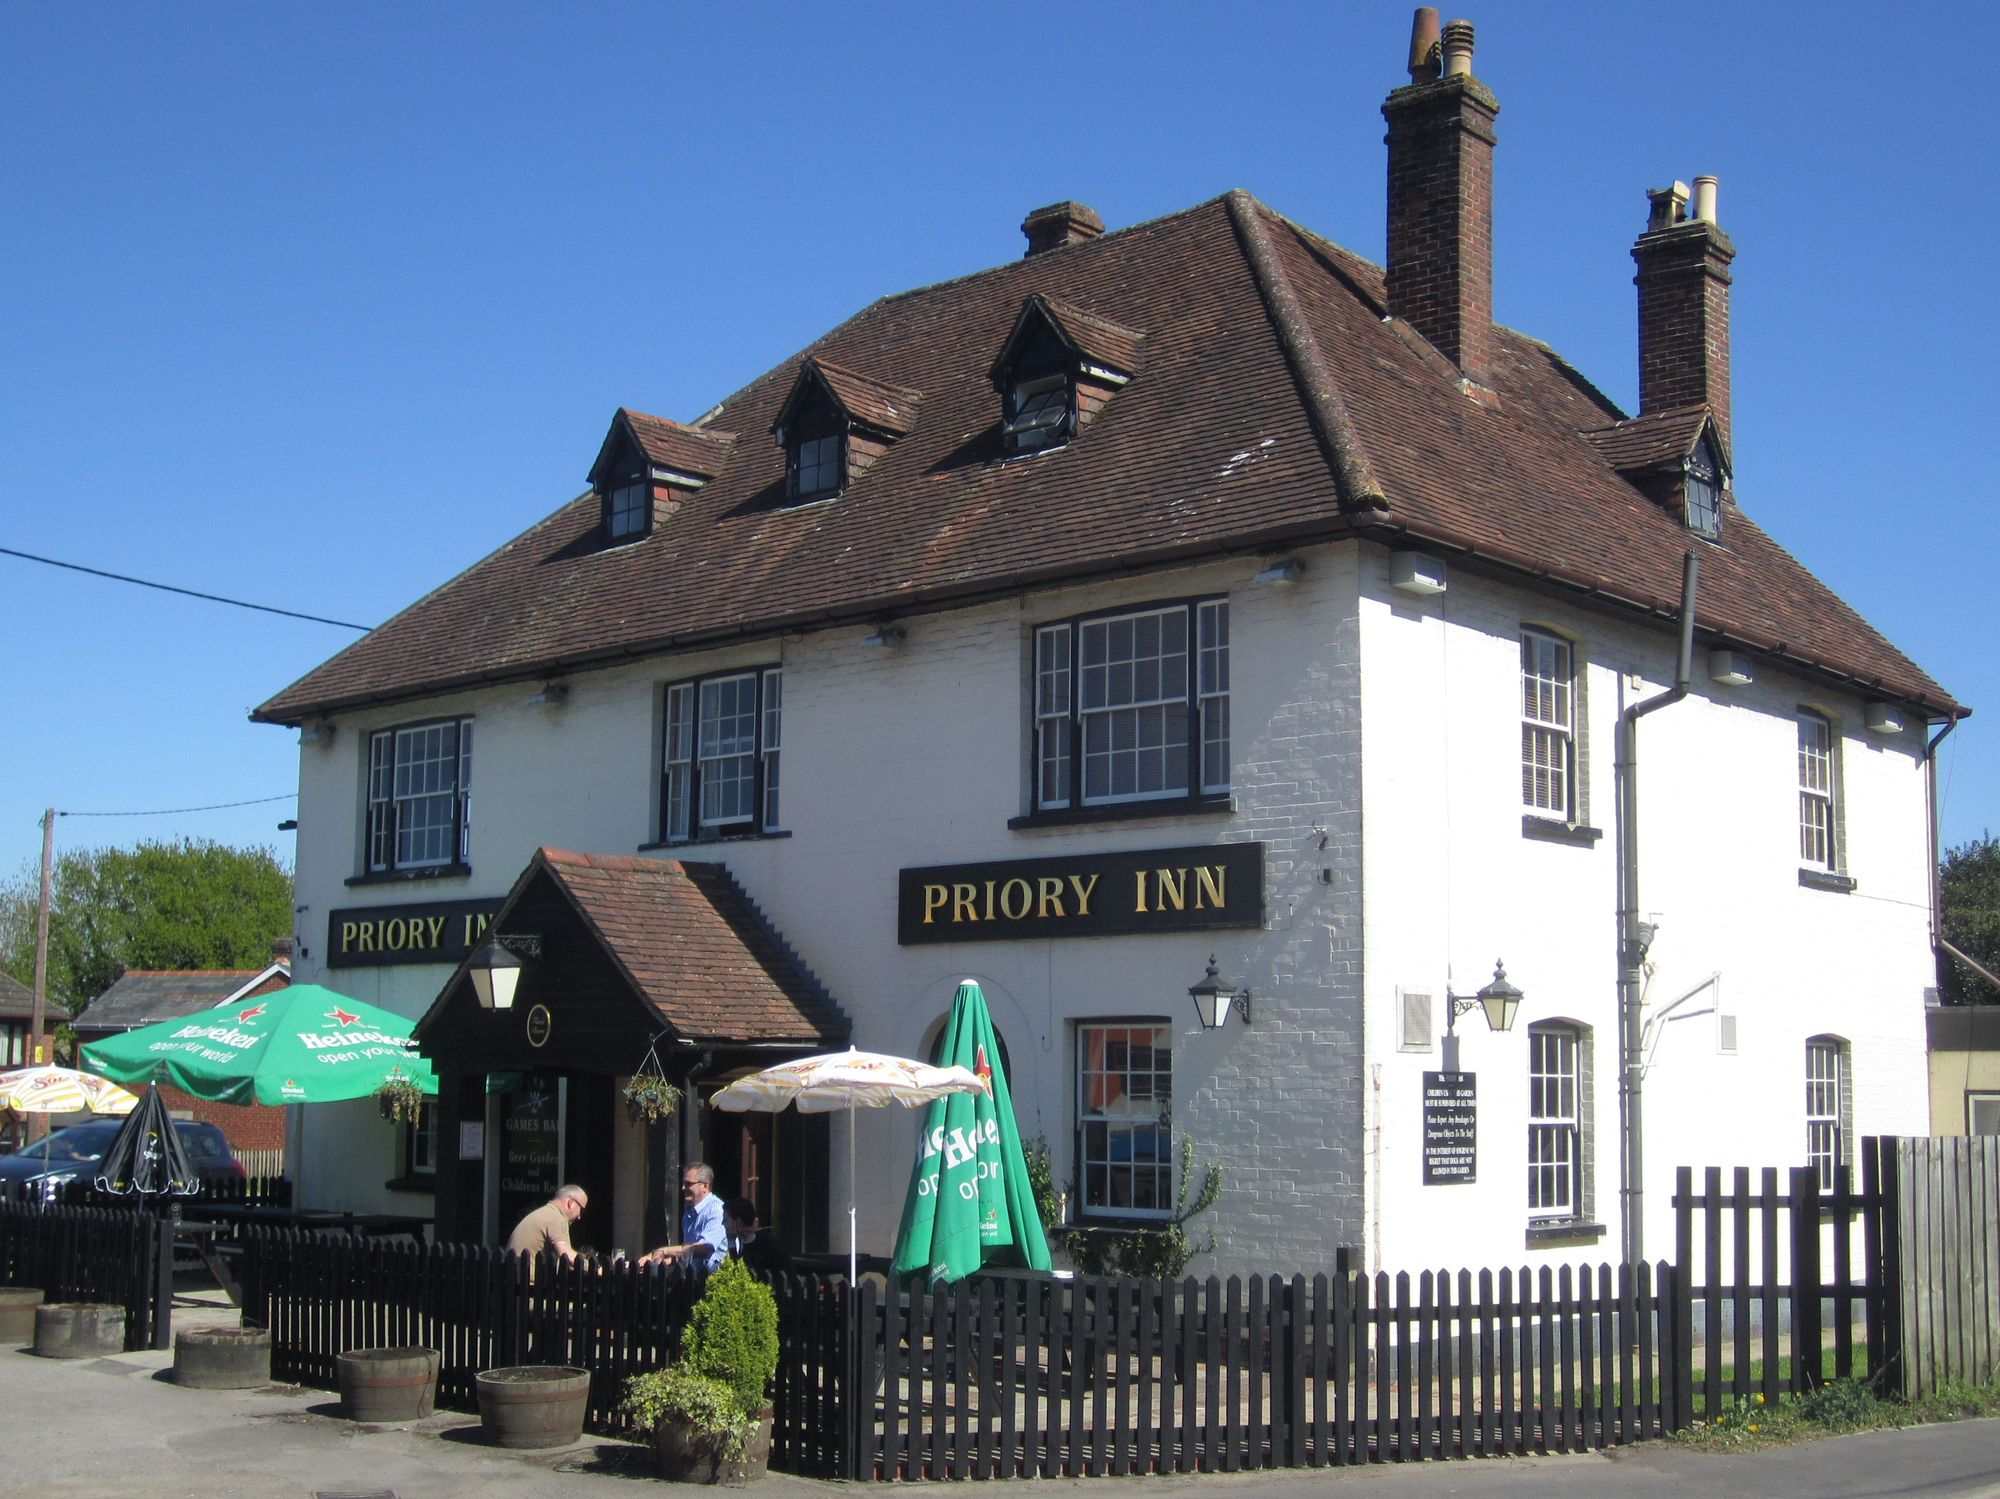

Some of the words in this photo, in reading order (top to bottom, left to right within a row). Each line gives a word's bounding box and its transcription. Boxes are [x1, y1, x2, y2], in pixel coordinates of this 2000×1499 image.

[923, 874, 1100, 924] PRIORY
[1135, 865, 1229, 913] INN
[341, 916, 445, 952] PRIORY
[464, 913, 494, 946] IN
[199, 1047, 239, 1064] world
[317, 1051, 359, 1065] open
[360, 1046, 397, 1060] your
[506, 1118, 540, 1132] GAMES
[543, 1119, 560, 1132] BA
[508, 1150, 526, 1163] Beer
